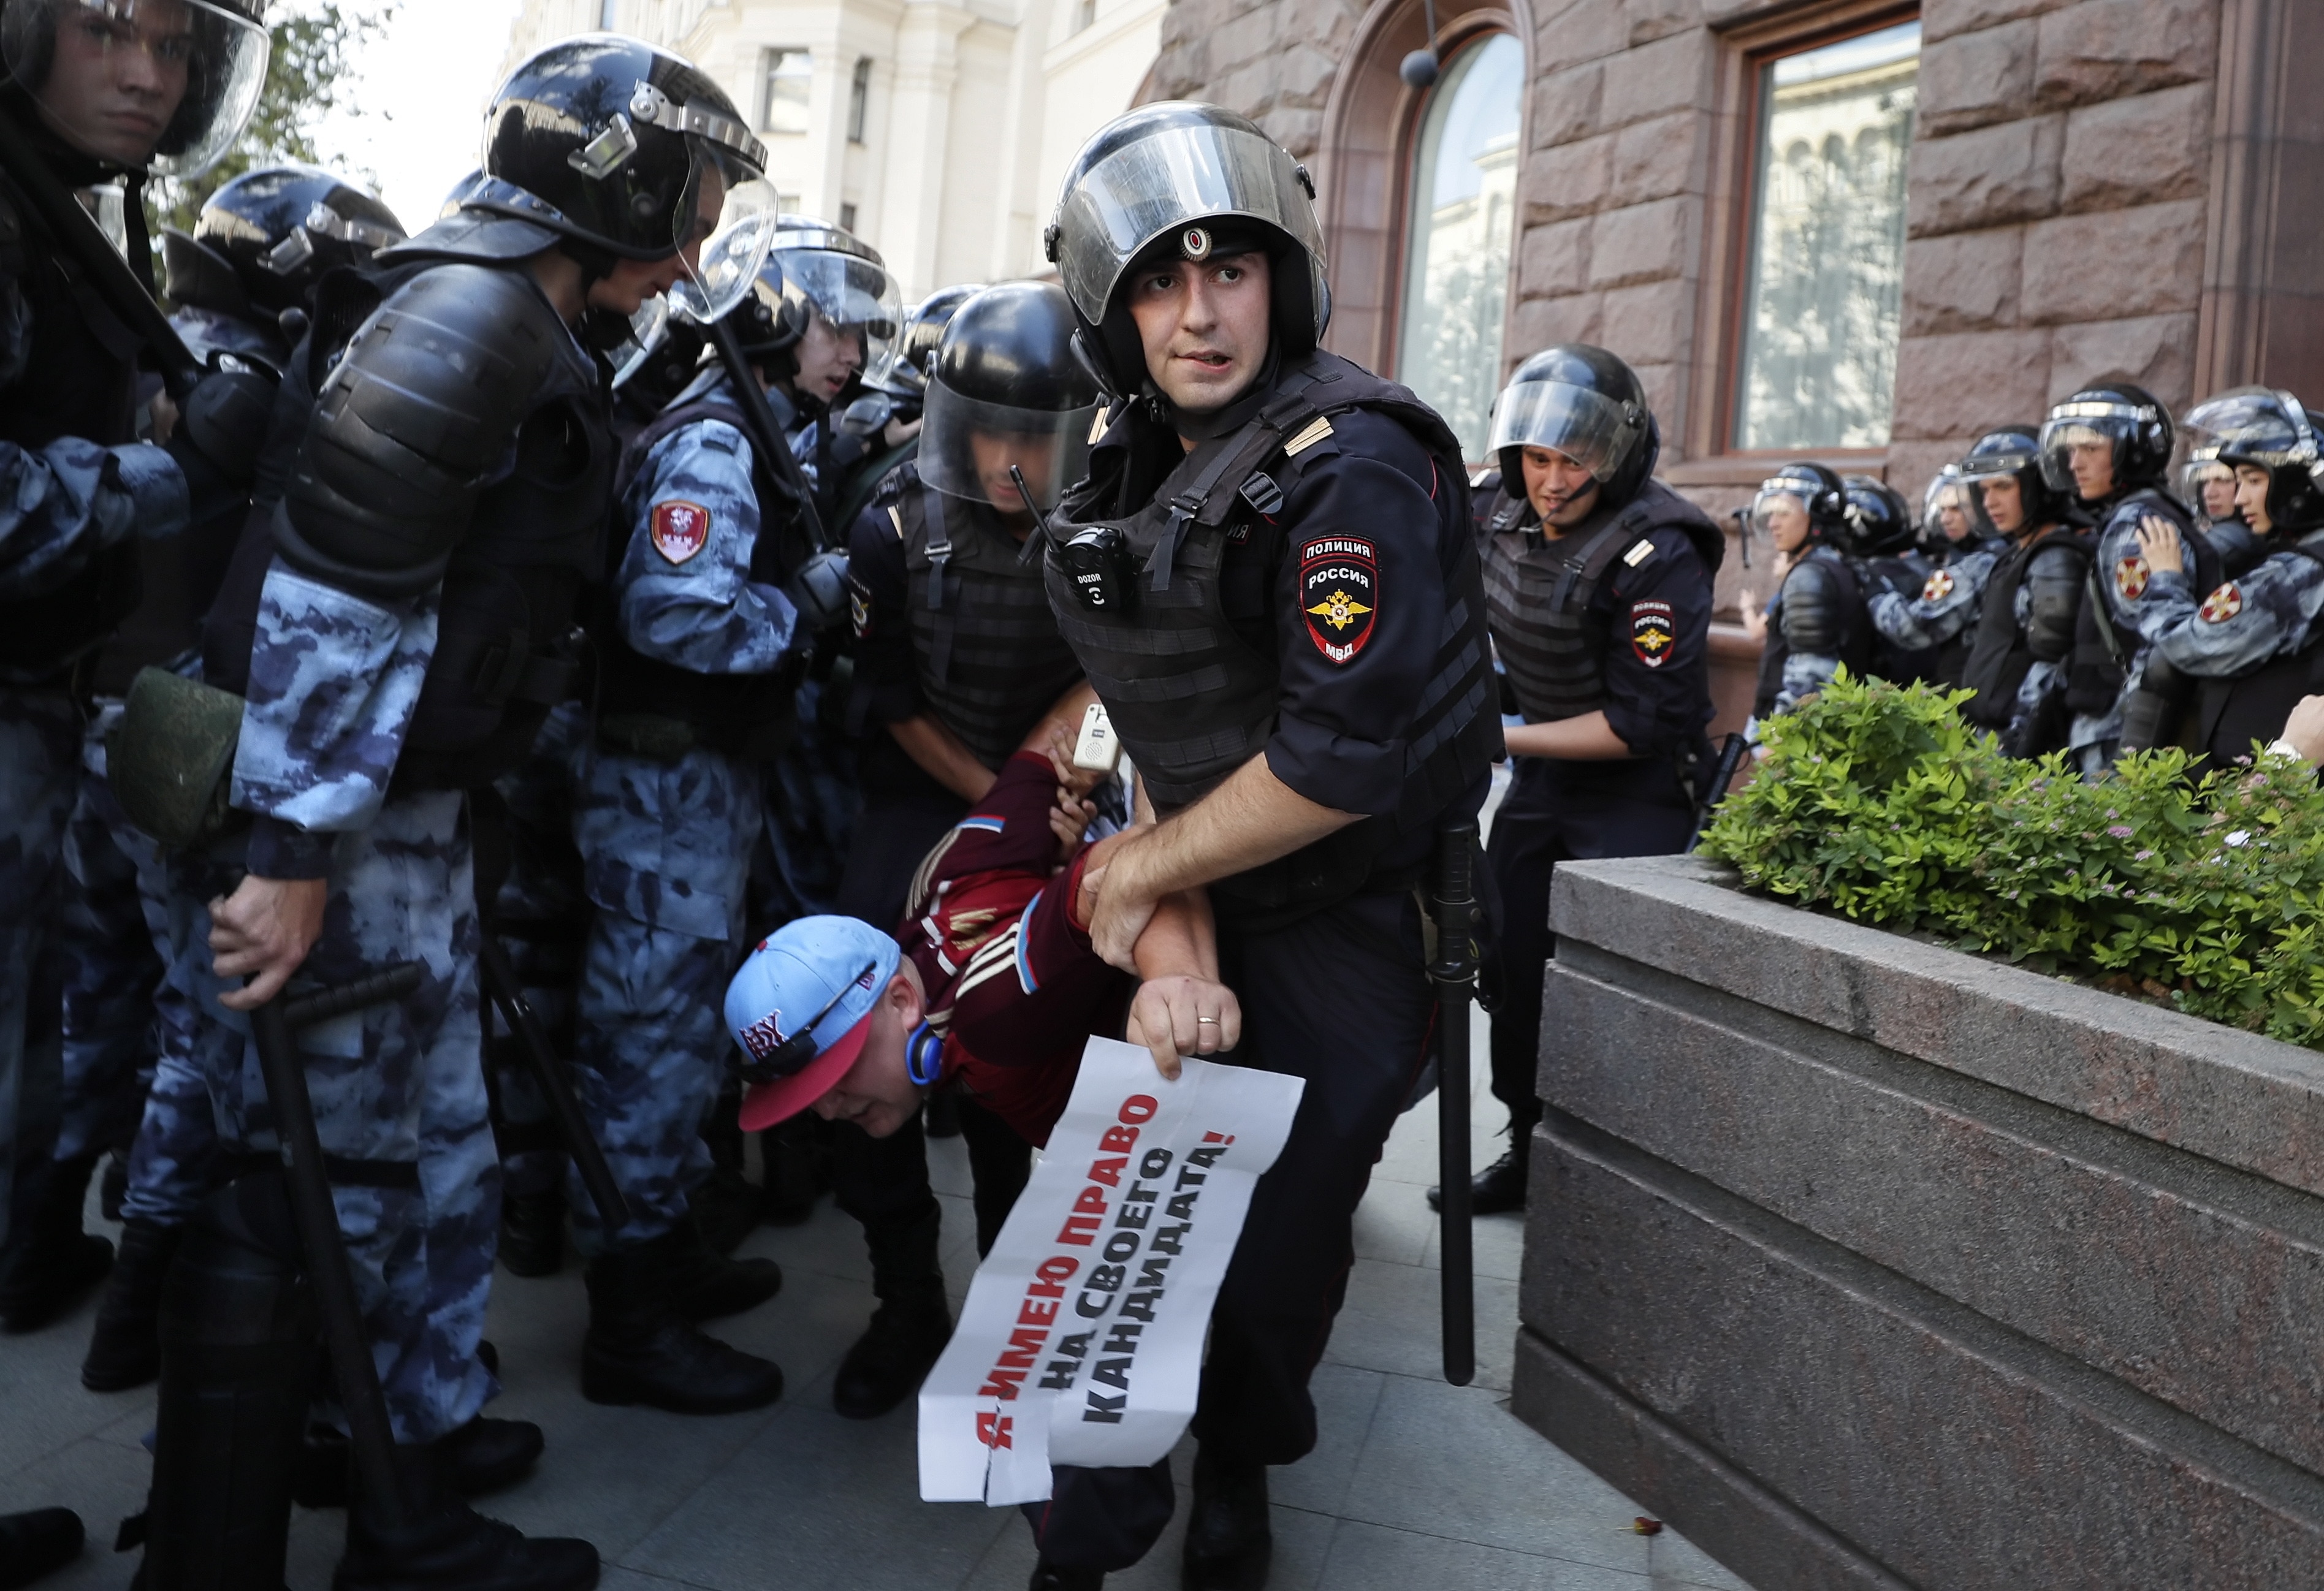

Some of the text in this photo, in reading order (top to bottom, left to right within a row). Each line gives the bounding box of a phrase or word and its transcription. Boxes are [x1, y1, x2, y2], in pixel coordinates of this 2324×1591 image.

[1306, 541, 1371, 559] ПОЛИЦИЯ
[1077, 572, 1102, 584] DOZOR
[1308, 567, 1369, 590] РОССИЯ
[1325, 642, 1354, 661] МВД
[977, 1094, 1158, 1451] Я ИМЕЮ ПРАВО
[1037, 1147, 1175, 1391] НА СВОЕГО
[1081, 1131, 1236, 1424] КАНДИДАТА!
